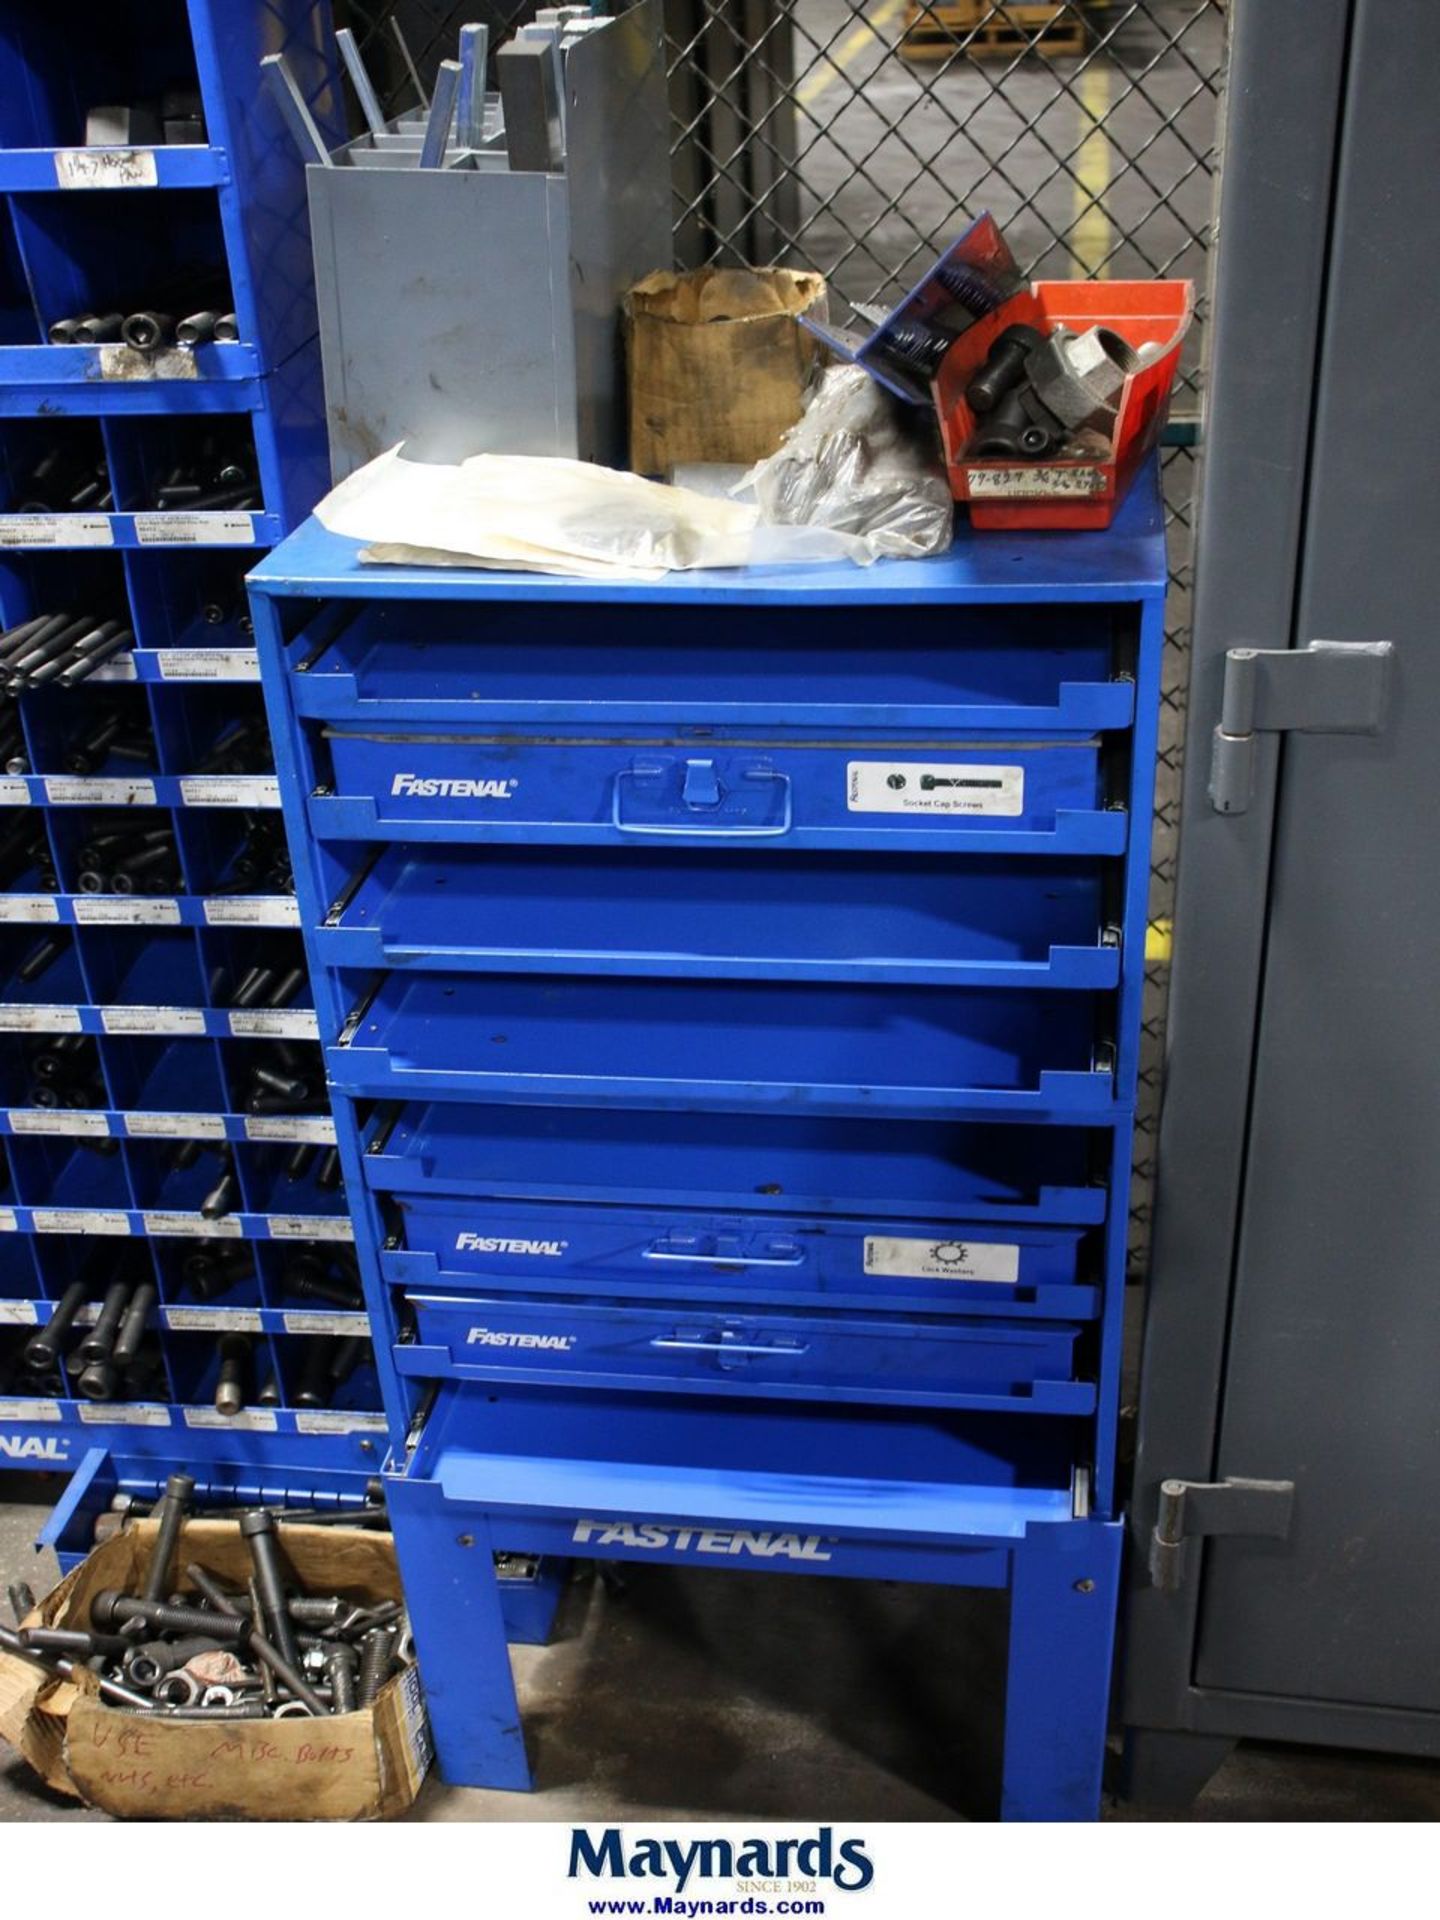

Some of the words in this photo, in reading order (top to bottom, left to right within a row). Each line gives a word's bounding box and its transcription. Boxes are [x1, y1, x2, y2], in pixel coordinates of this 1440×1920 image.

[391, 773, 513, 798] FASTENAL
[934, 800, 951, 809] Cap
[456, 1232, 562, 1256] FASTENAL
[467, 1327, 571, 1350] FASTENAL
